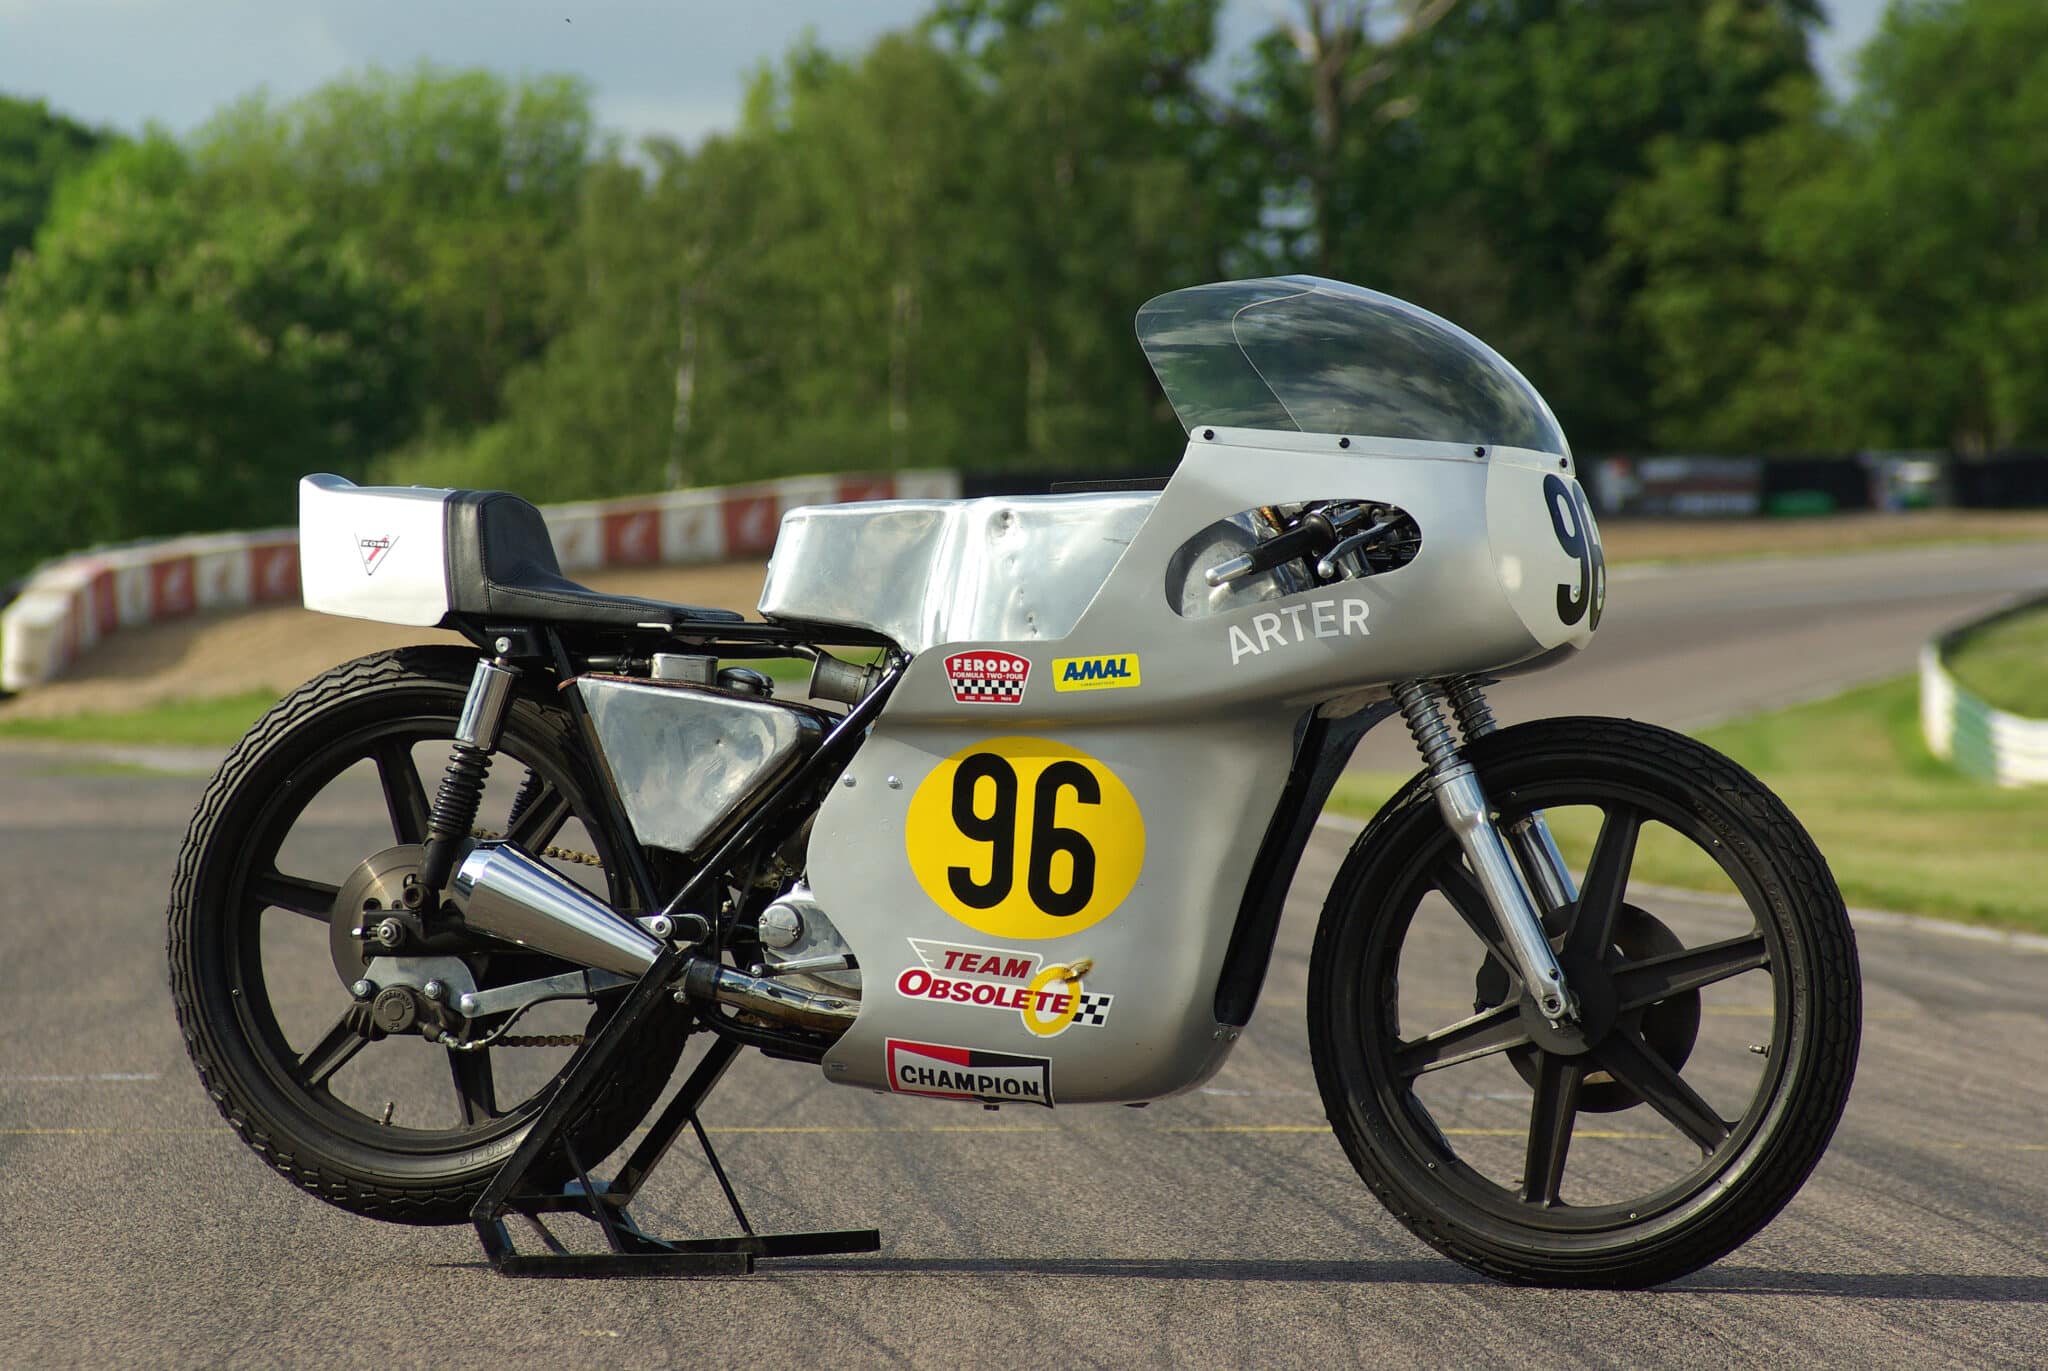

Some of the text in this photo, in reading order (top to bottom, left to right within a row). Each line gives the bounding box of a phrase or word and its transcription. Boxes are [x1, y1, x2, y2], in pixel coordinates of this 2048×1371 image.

[1229, 598, 1370, 665] ARTER
[953, 658, 1024, 672] FERODO
[1063, 658, 1131, 682] AMAL
[947, 752, 1101, 917] 96
[944, 950, 1032, 979] TEAM
[898, 969, 1073, 1014] OBSOLETE
[900, 1065, 1039, 1096] CHAMPION
